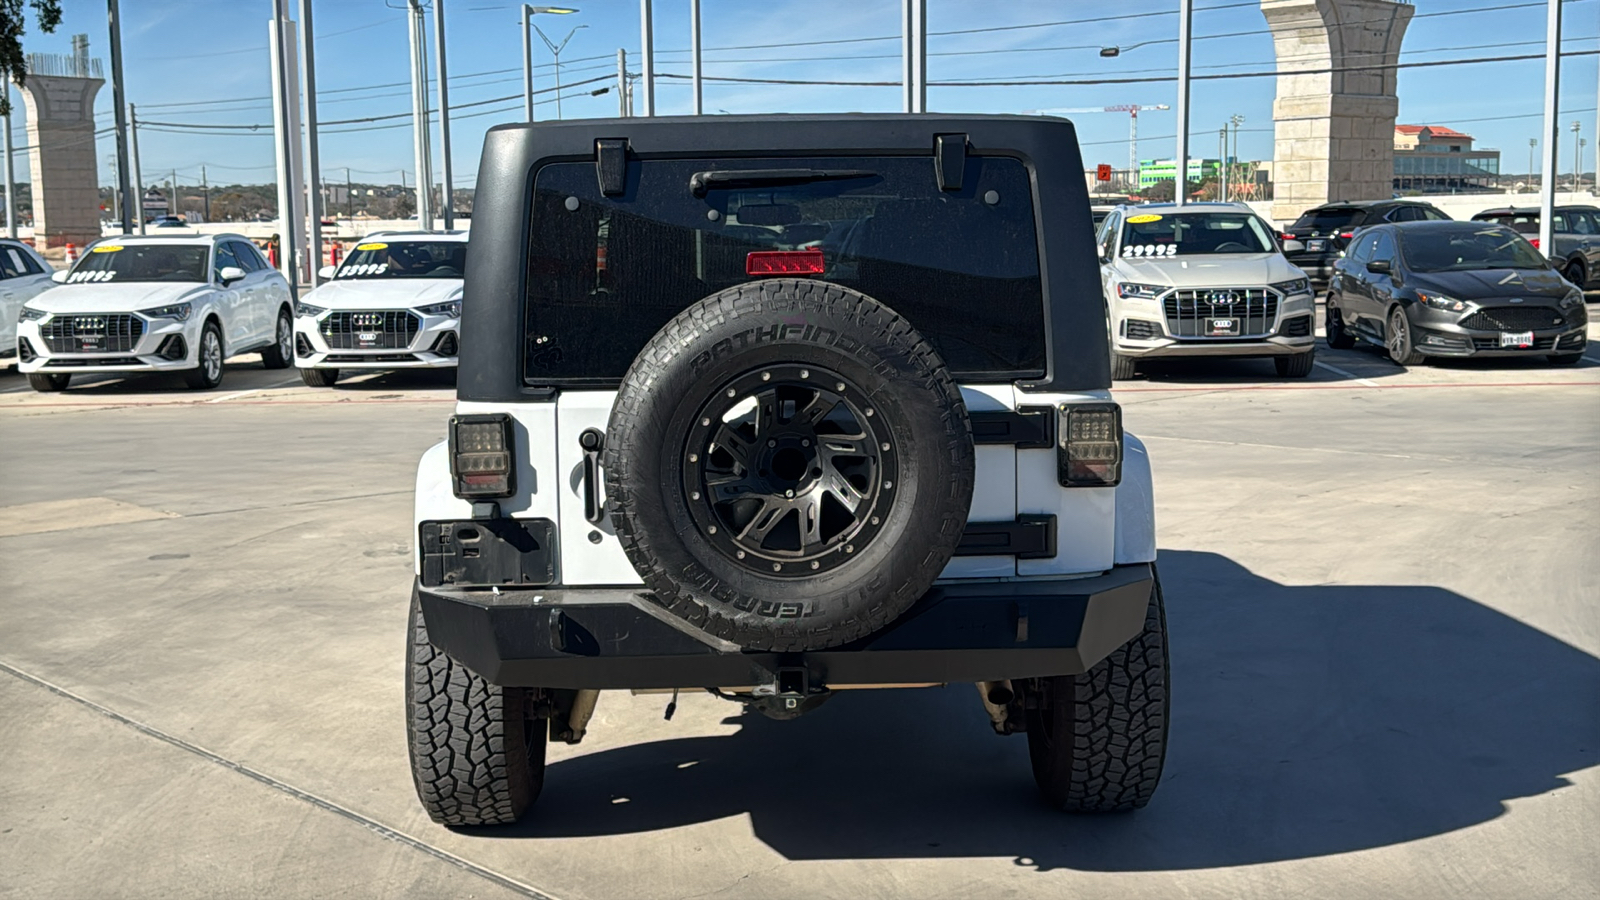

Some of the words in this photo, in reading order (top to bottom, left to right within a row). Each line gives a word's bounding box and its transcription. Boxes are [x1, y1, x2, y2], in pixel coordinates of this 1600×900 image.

[1122, 244, 1178, 258] 29995
[689, 323, 899, 380] PATHFINDER
[682, 562, 828, 619] TERRAIN
